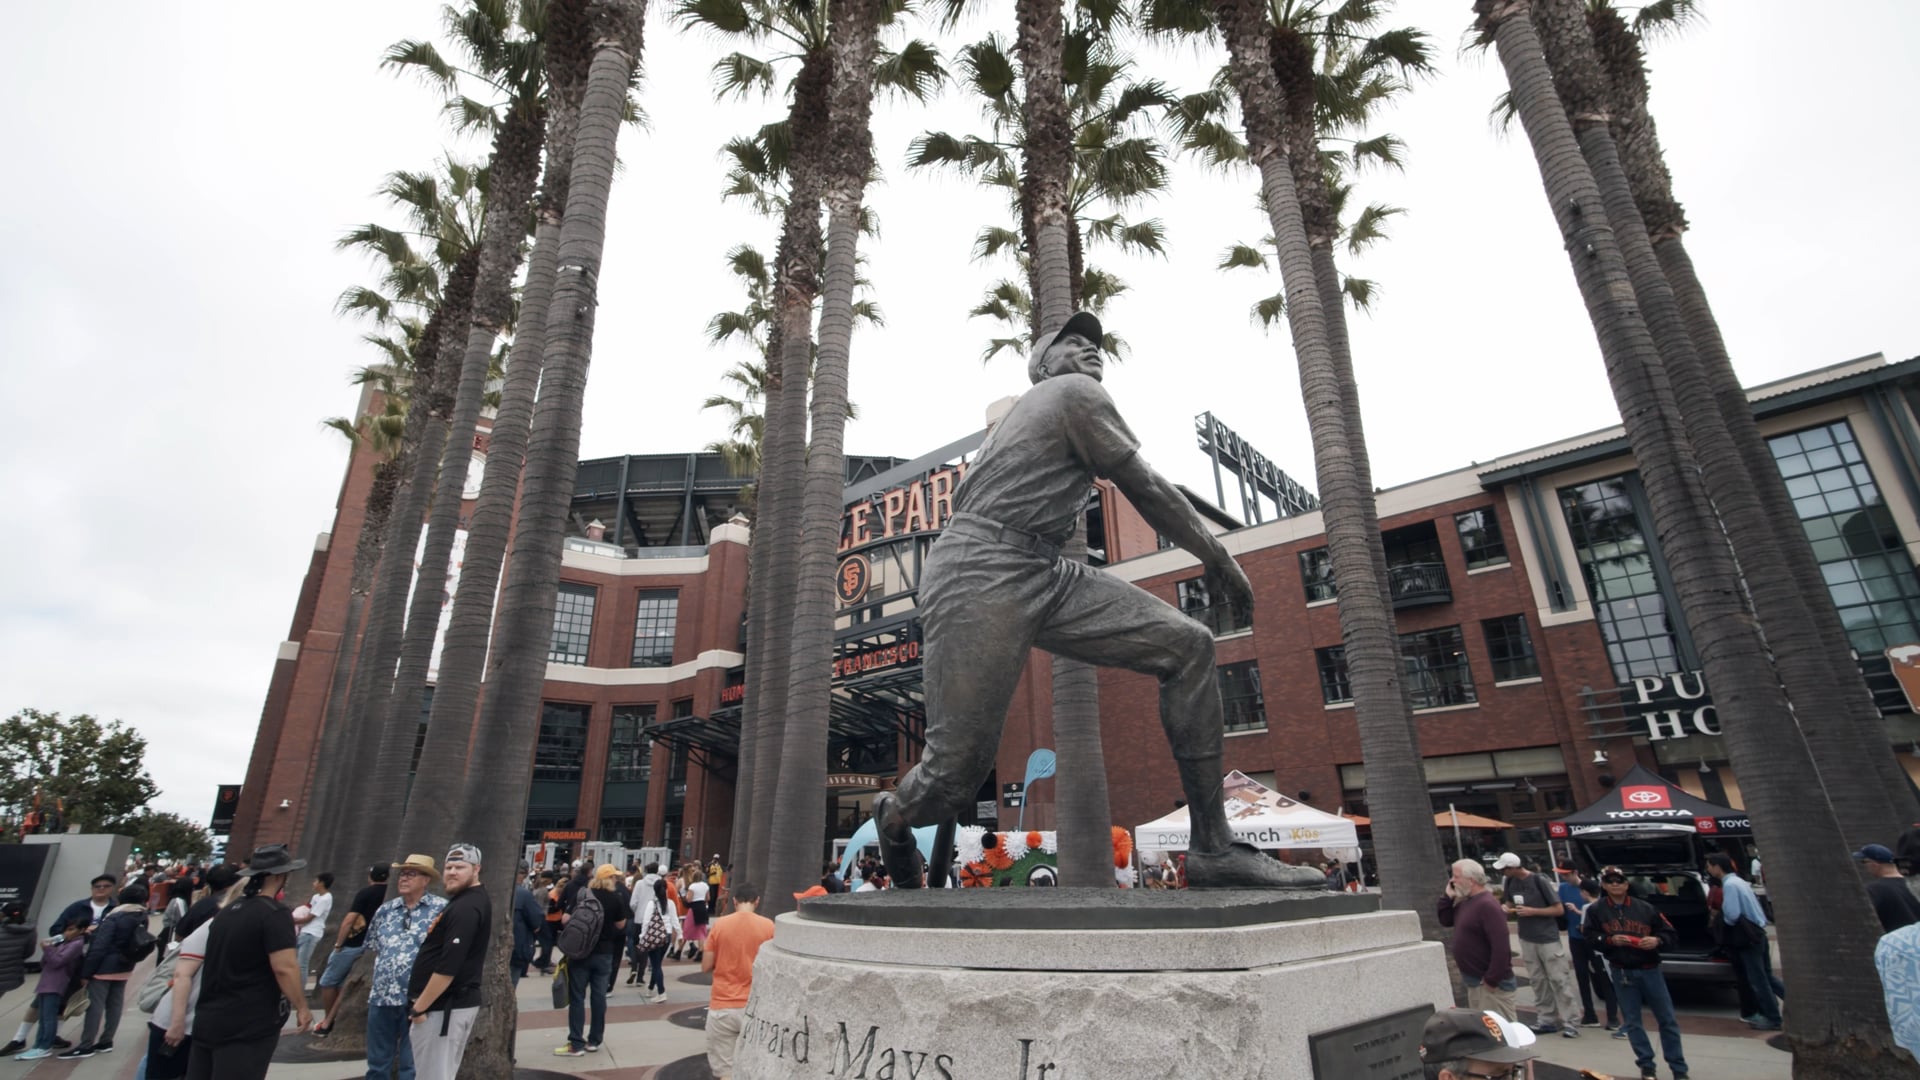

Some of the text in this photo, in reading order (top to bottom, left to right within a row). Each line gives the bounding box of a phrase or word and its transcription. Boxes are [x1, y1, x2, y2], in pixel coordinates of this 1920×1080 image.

[883, 462, 970, 539] PAR
[834, 640, 919, 677] FRANCISCO
[1631, 669, 1706, 705] PU
[848, 775, 878, 786] GATE
[1606, 809, 1694, 819] TOYOTA
[543, 831, 587, 841] PROGRAMS
